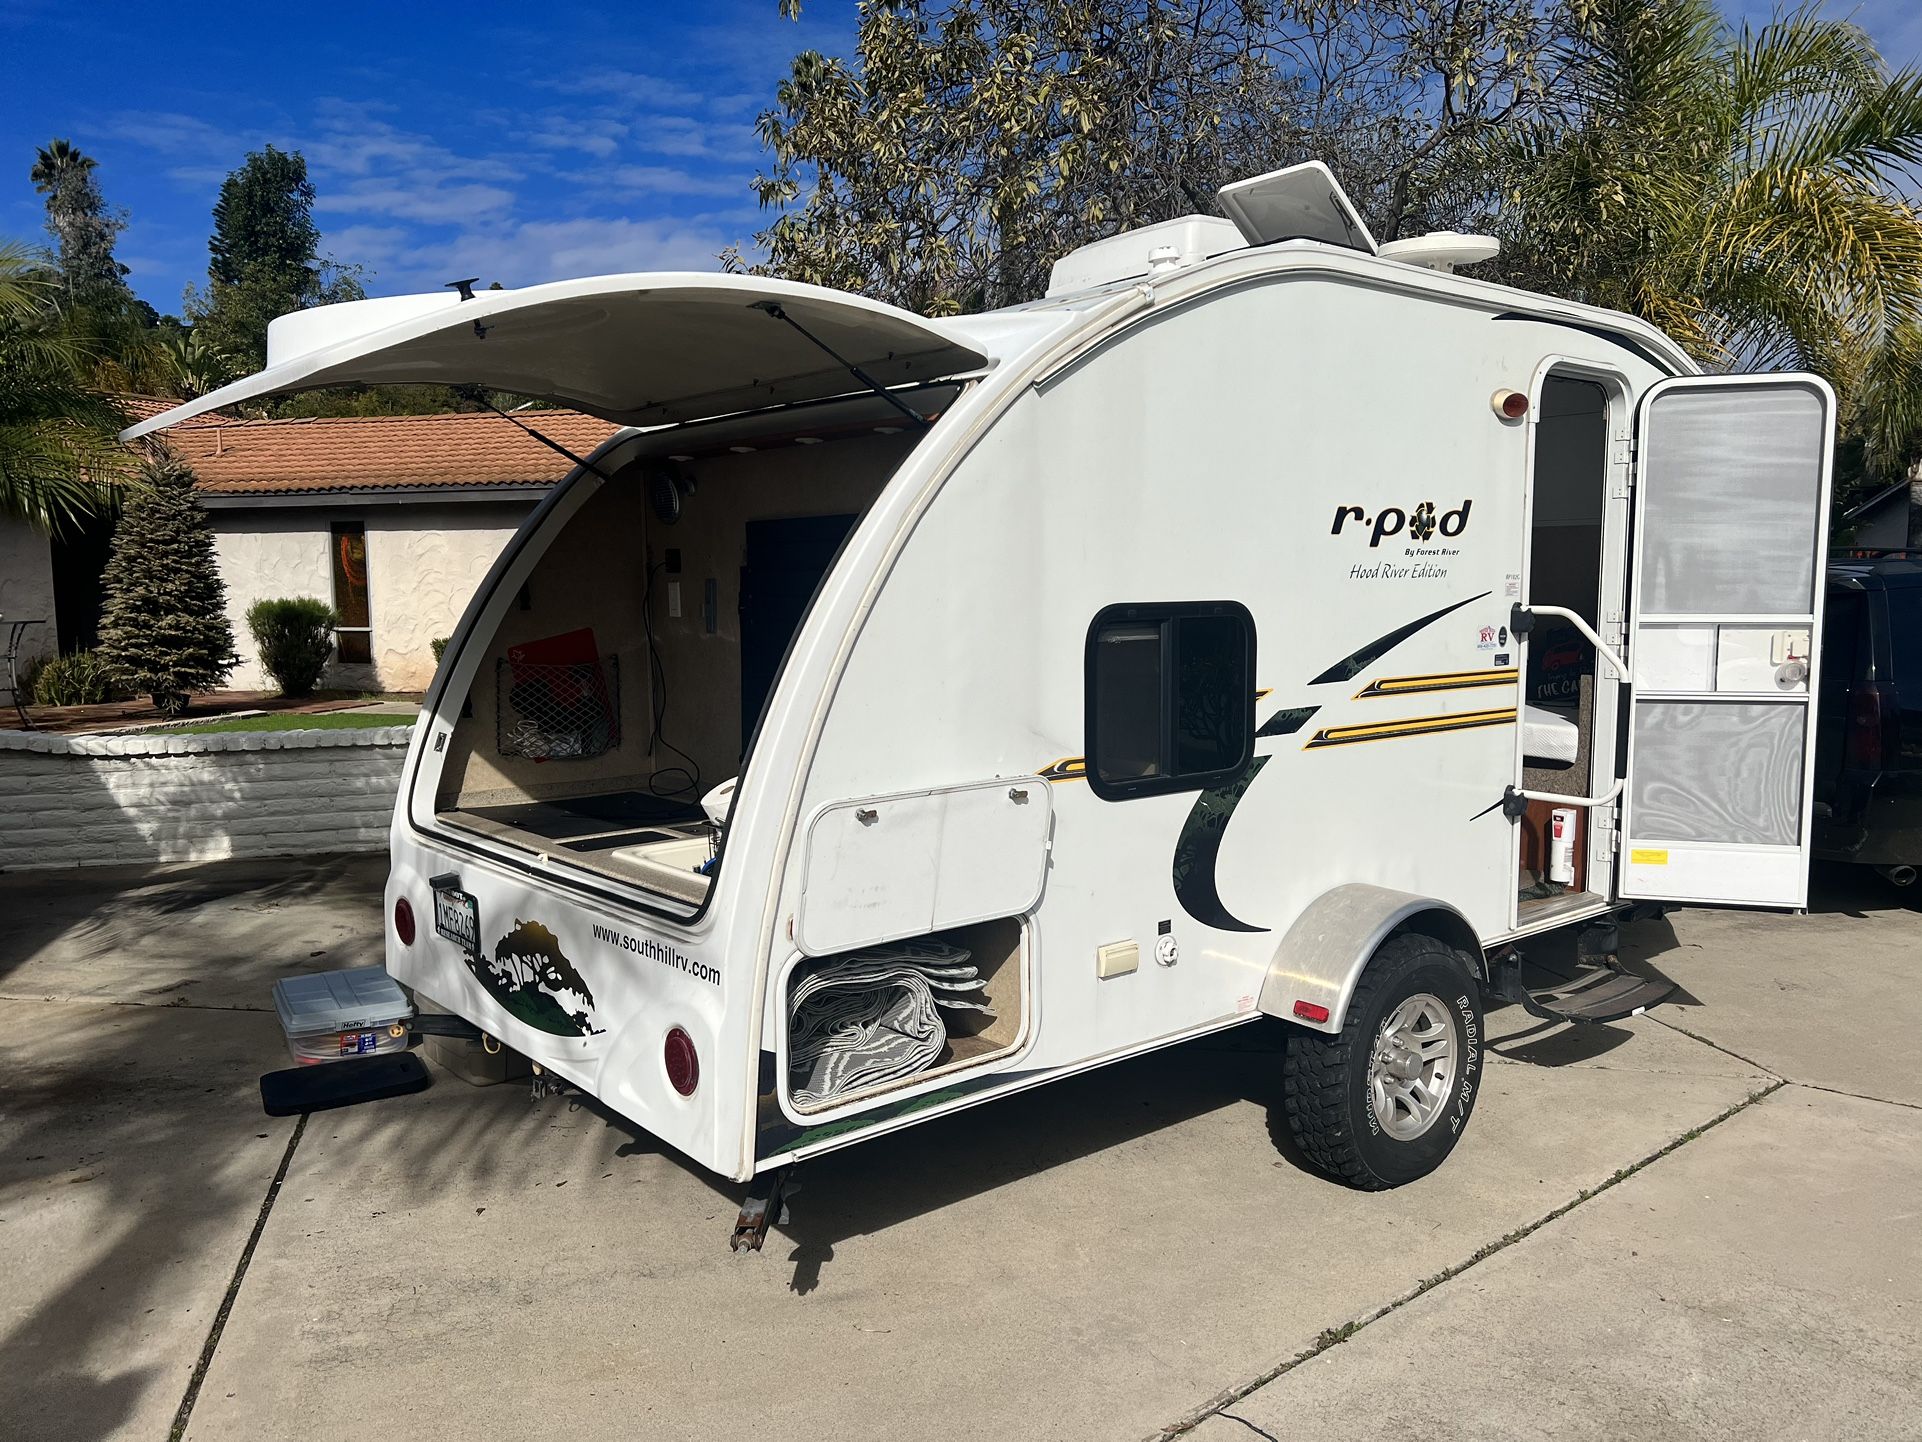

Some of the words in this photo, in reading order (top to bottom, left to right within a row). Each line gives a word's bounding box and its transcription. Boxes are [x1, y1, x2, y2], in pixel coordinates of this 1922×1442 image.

[1405, 548, 1414, 557] By
[1350, 561, 1381, 579] Hood
[1381, 563, 1410, 579] River
[1411, 561, 1447, 579] Edition
[1480, 632, 1495, 641] RV
[1537, 682, 1560, 699] THE
[592, 923, 721, 986] www.southhillrv.com
[342, 1021, 364, 1029] Hefty
[1456, 995, 1478, 1075] RADIAL
